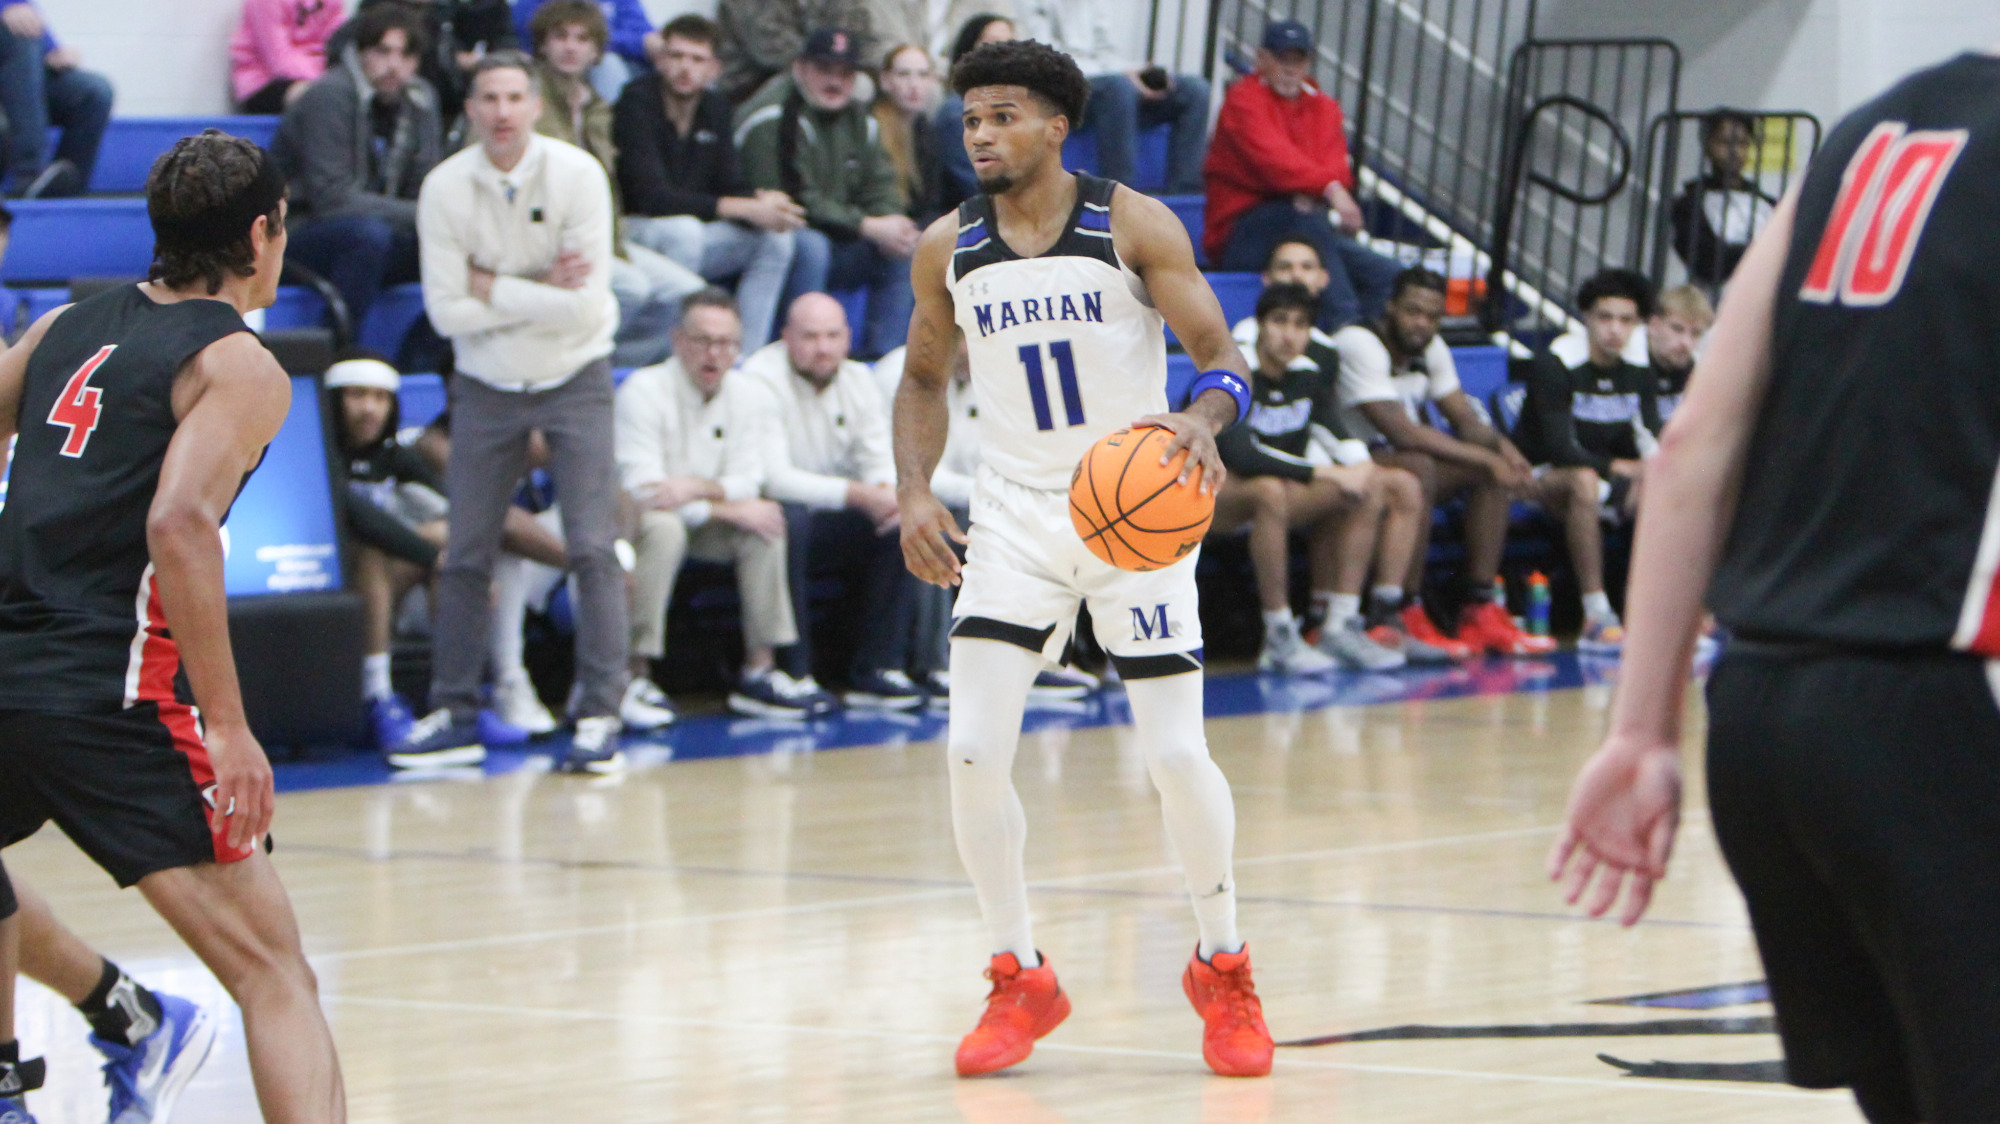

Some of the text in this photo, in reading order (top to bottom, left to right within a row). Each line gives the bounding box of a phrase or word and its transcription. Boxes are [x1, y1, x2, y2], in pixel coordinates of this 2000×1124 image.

[1798, 120, 1970, 307] 10
[973, 291, 1103, 337] MARIAN
[45, 343, 119, 458] 4
[1017, 339, 1086, 431] 11
[1128, 603, 1175, 641] M
